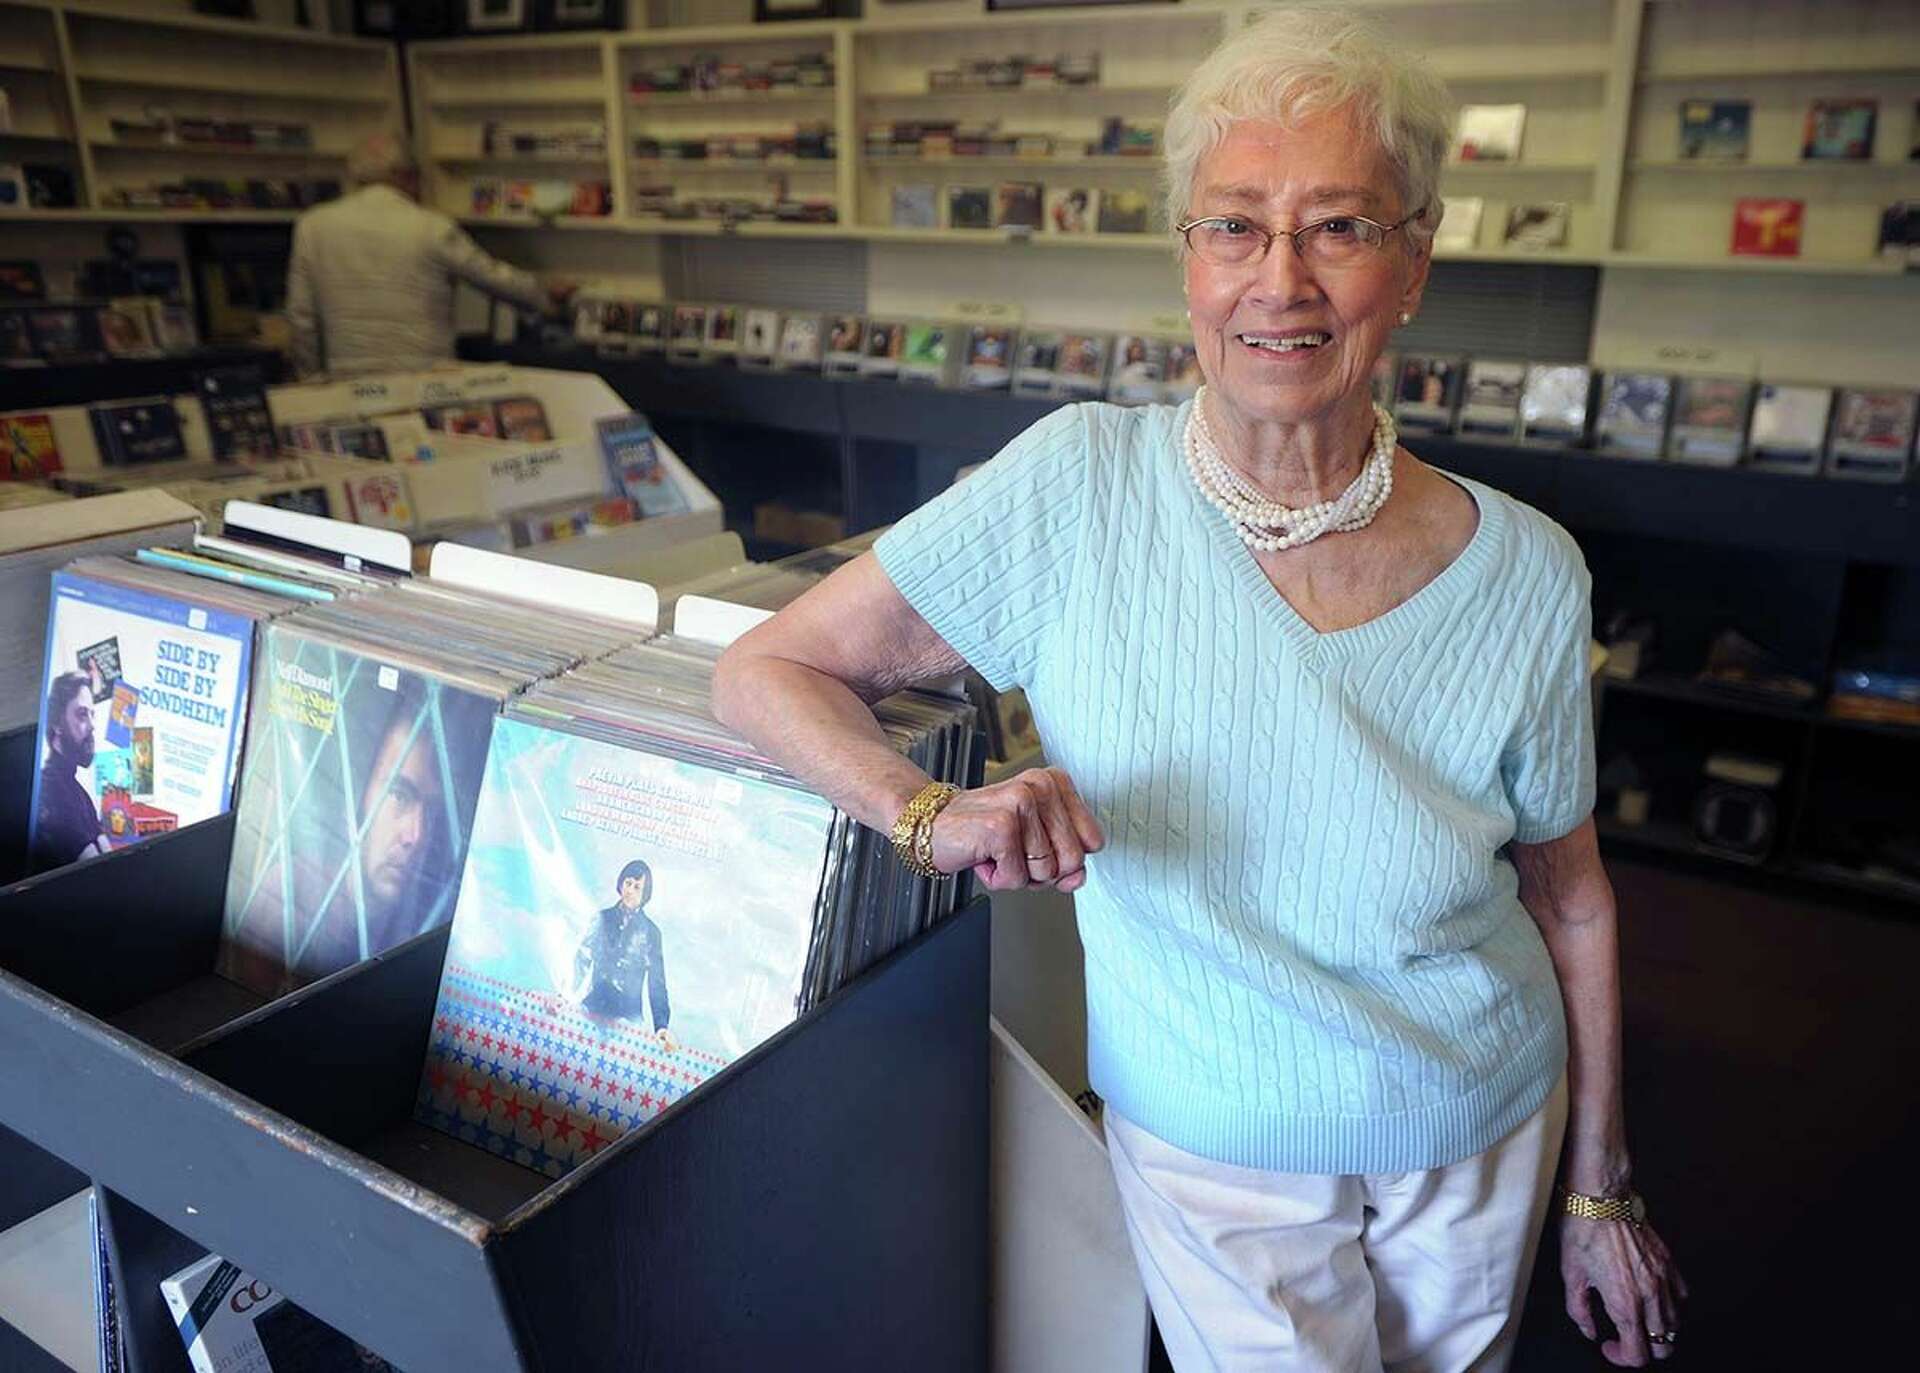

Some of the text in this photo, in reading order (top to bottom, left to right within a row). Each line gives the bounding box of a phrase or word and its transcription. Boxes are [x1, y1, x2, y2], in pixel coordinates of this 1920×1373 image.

[157, 640, 221, 673] SIDE BY
[154, 664, 217, 698] SIDE BY
[140, 686, 227, 728] SONDHEIM
